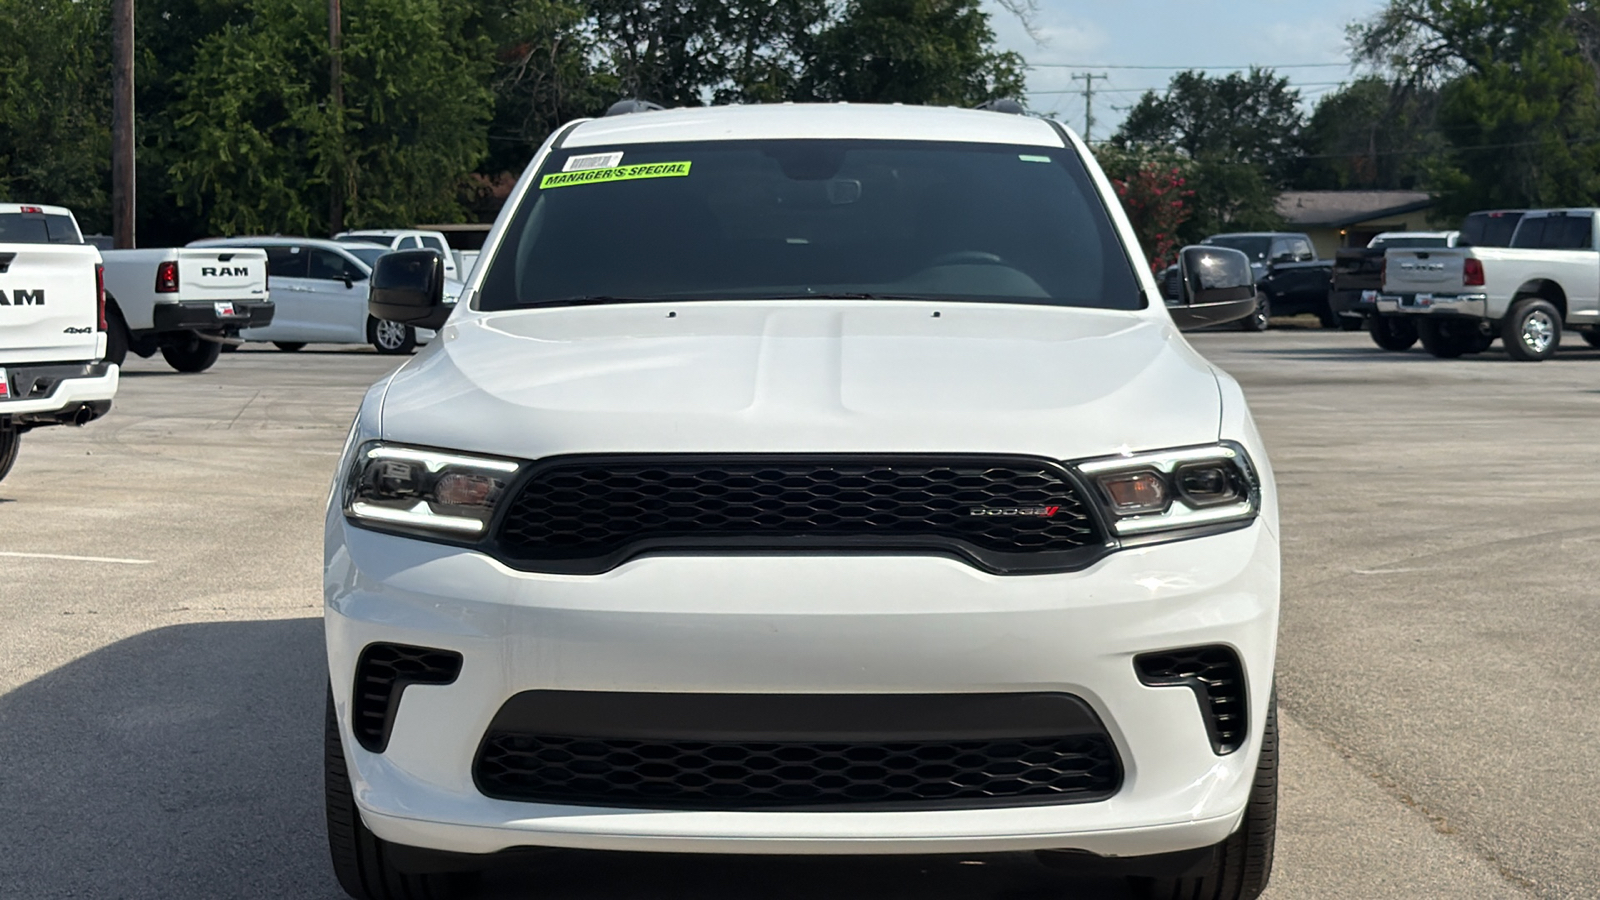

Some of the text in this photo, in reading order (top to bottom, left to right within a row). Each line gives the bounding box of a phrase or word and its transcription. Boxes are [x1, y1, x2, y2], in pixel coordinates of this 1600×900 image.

[545, 164, 686, 185] MANAGER'S SPECIAL
[201, 267, 249, 276] RAM
[970, 506, 1048, 516] DODGE
